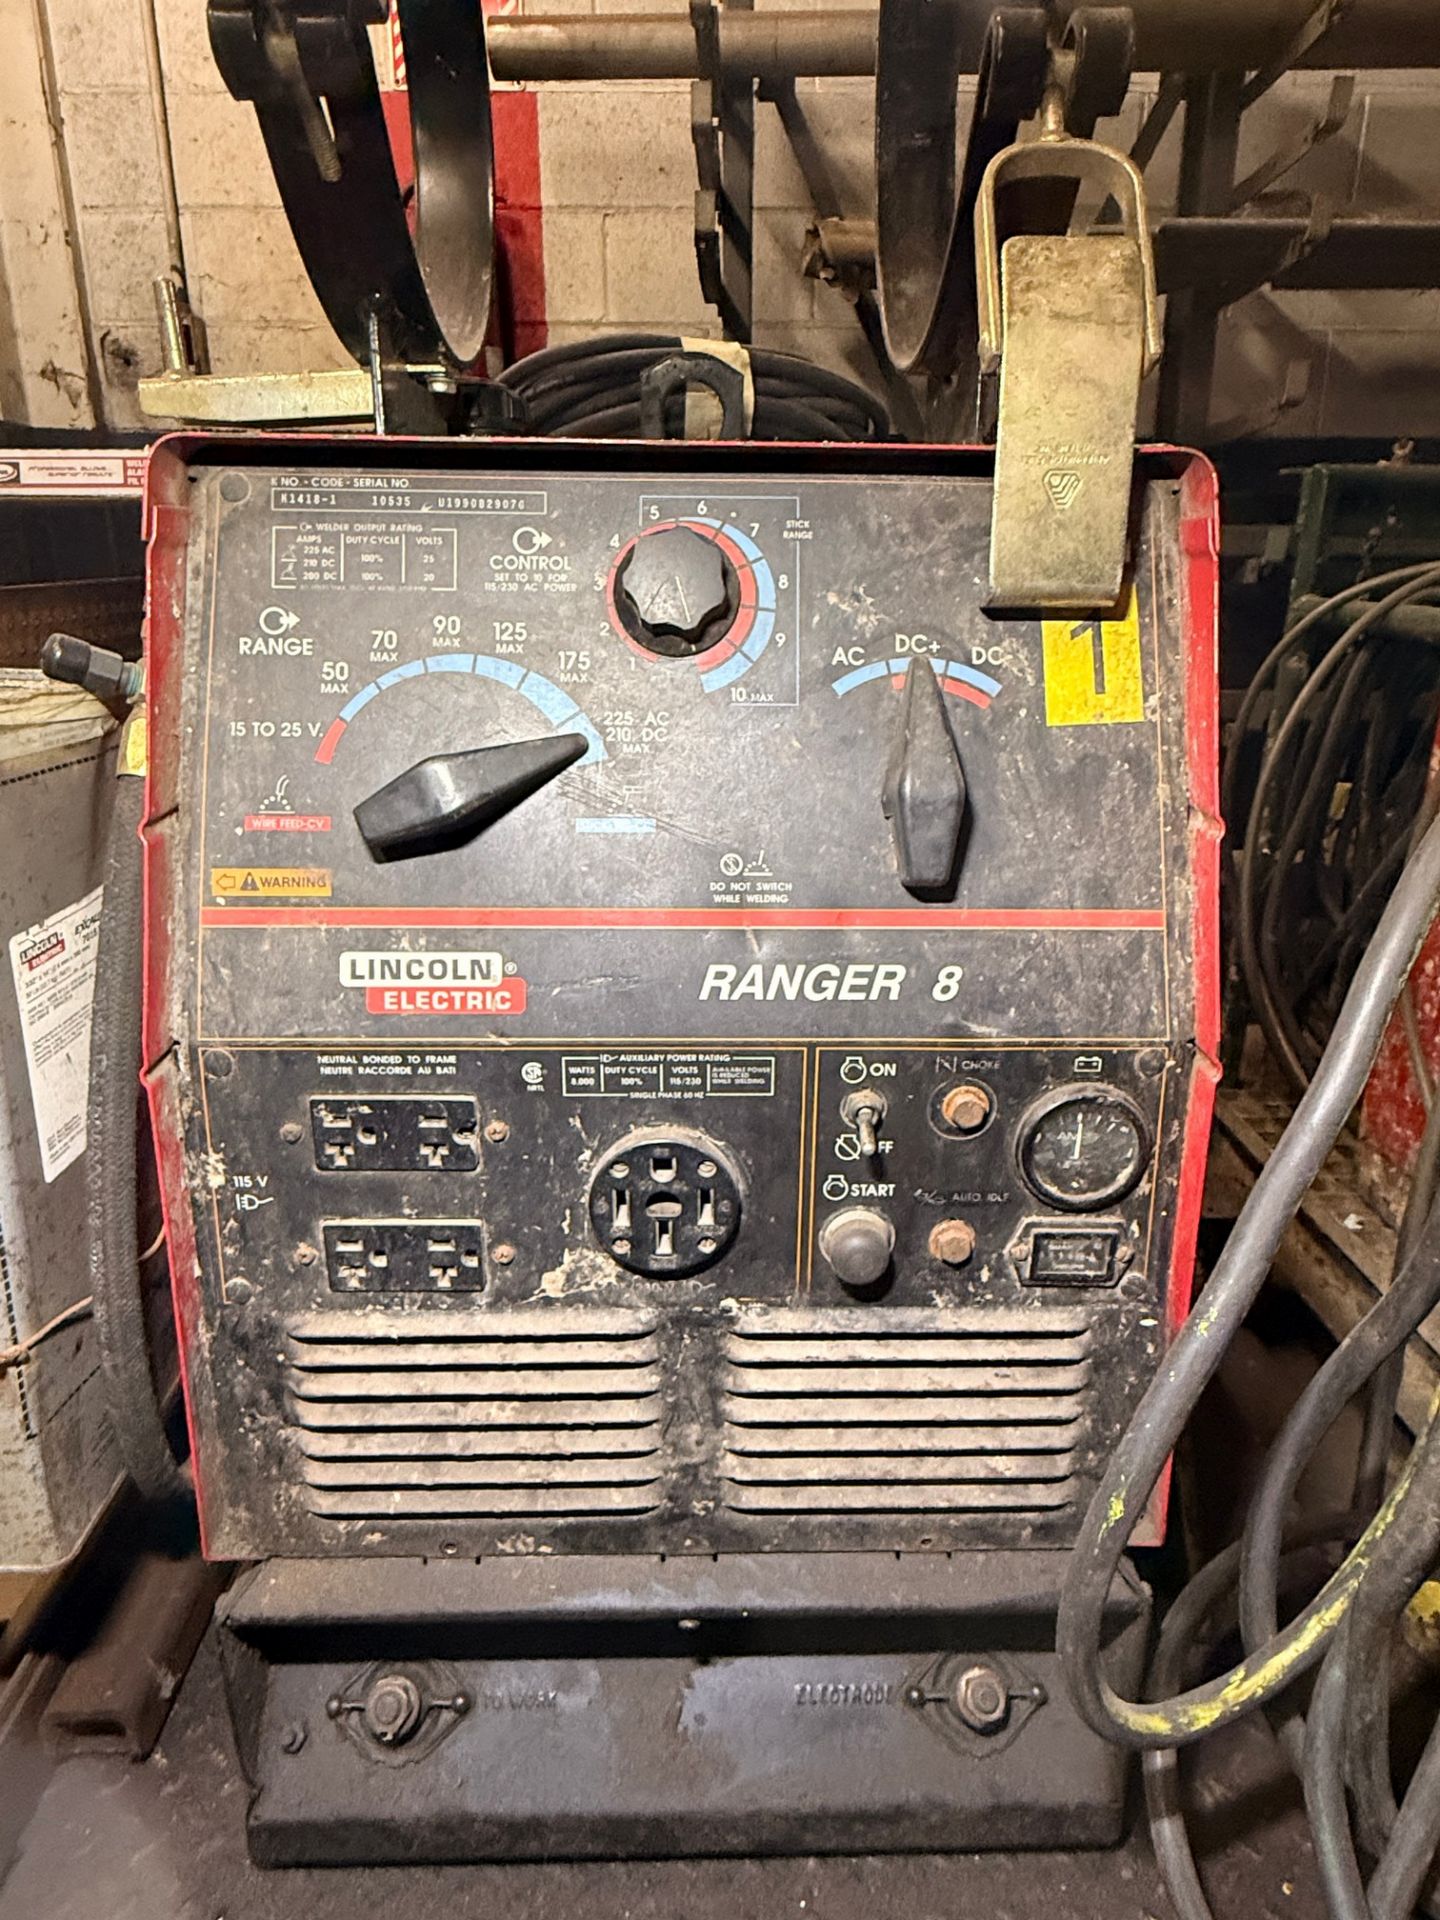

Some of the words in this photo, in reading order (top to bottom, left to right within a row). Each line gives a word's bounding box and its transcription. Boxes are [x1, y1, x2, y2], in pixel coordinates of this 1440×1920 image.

[311, 478, 344, 488] CODE
[353, 479, 388, 488] SERIAL
[372, 495, 411, 507] 10535
[649, 505, 660, 520] 5
[696, 501, 707, 515] 6
[315, 522, 350, 532] WELDER
[353, 523, 387, 532] OUTPUT
[390, 523, 423, 533] RATING
[750, 522, 760, 537] 7
[785, 519, 810, 529] STICK
[296, 535, 322, 544] AMPS
[345, 535, 368, 545] DUTY
[370, 536, 400, 545] CYCLE
[416, 537, 443, 546] VOLTS
[783, 530, 813, 540] RANGE
[609, 534, 620, 549] 4
[322, 546, 336, 555] AC
[322, 559, 336, 568] DC
[489, 554, 572, 570] CONTROL
[323, 572, 337, 581] DC
[423, 573, 435, 582] 20
[494, 573, 510, 582] SET
[515, 573, 528, 583] TO
[548, 573, 568, 583] FOR
[778, 575, 789, 590] 8
[523, 583, 539, 592] AC
[543, 583, 578, 593] POWER
[432, 615, 461, 635] 90
[600, 622, 610, 637] 2
[492, 622, 528, 641] 125
[371, 630, 398, 650] 70
[432, 636, 462, 648] MAX
[775, 633, 786, 648] 9
[895, 633, 942, 654] DC+
[238, 637, 313, 656] RANGE
[495, 643, 525, 654] MAX
[370, 651, 399, 662] MAX
[558, 651, 591, 670] 175
[831, 647, 866, 666] AC
[1069, 621, 1106, 695] 1
[629, 657, 636, 671] 1
[321, 661, 349, 681] 50
[560, 671, 589, 682] MAX
[320, 682, 349, 693] MAX
[731, 688, 748, 702] 10
[750, 693, 774, 702] MAX
[603, 711, 634, 726] 225
[644, 710, 670, 726] AC
[230, 721, 247, 737] 15
[252, 721, 275, 737] TO
[280, 722, 301, 738] 25
[605, 727, 632, 742] 210
[642, 727, 668, 742] DC
[622, 743, 650, 754] MAX
[251, 819, 277, 829] WIRE
[260, 876, 327, 888] WARNING
[709, 882, 726, 891] DO
[730, 882, 751, 891] NOT
[756, 882, 793, 892] SWITCH
[713, 894, 741, 904] WHILE
[746, 894, 789, 904] WELDING
[350, 958, 492, 981] LINCOLN
[699, 963, 907, 1001] RANGER
[932, 965, 964, 1002] 8
[383, 990, 513, 1011] ELECTRIC
[317, 1054, 358, 1064] NEUTRAL
[363, 1054, 403, 1064] BONDED
[407, 1055, 421, 1064] TO
[425, 1055, 457, 1064] FRAME
[619, 1054, 665, 1063] AUXILIARY
[666, 1054, 697, 1063] POWER
[698, 1054, 731, 1063] RATING
[320, 1066, 353, 1076] NEUTRE
[358, 1066, 413, 1076] RACCORDE
[417, 1066, 432, 1076] AU
[436, 1066, 457, 1076] BATI
[568, 1066, 596, 1075] WATTS
[604, 1066, 626, 1075] DUTY
[628, 1066, 658, 1075] CYCLE
[671, 1066, 698, 1074] VOLTS
[869, 1063, 896, 1077] ON
[961, 1060, 1001, 1070] CHOKE
[629, 1091, 657, 1099] SINGLE
[657, 1091, 682, 1099] PHASE
[232, 1175, 253, 1187] 115
[255, 1176, 268, 1188] V
[850, 1183, 896, 1197] START
[952, 1191, 982, 1201] AUTO
